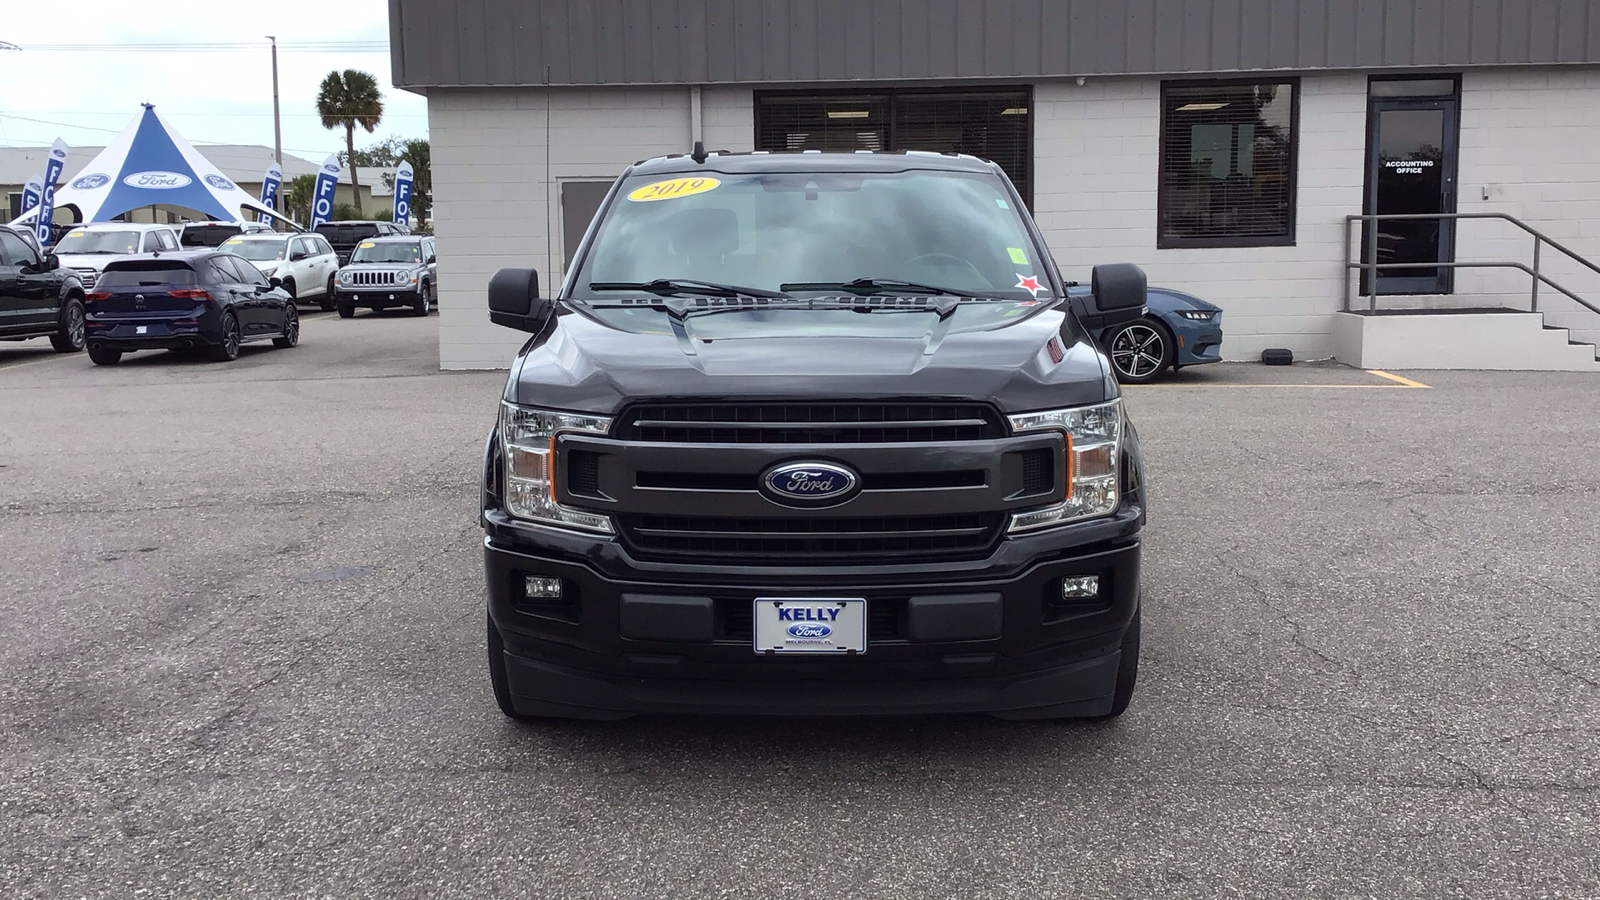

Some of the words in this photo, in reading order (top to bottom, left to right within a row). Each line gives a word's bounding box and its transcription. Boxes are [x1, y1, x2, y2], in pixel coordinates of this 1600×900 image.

[138, 174, 178, 186] Ford
[641, 178, 705, 199] 2019
[786, 471, 834, 491] Ford
[778, 607, 840, 621] KELLY
[795, 624, 823, 636] Ford
